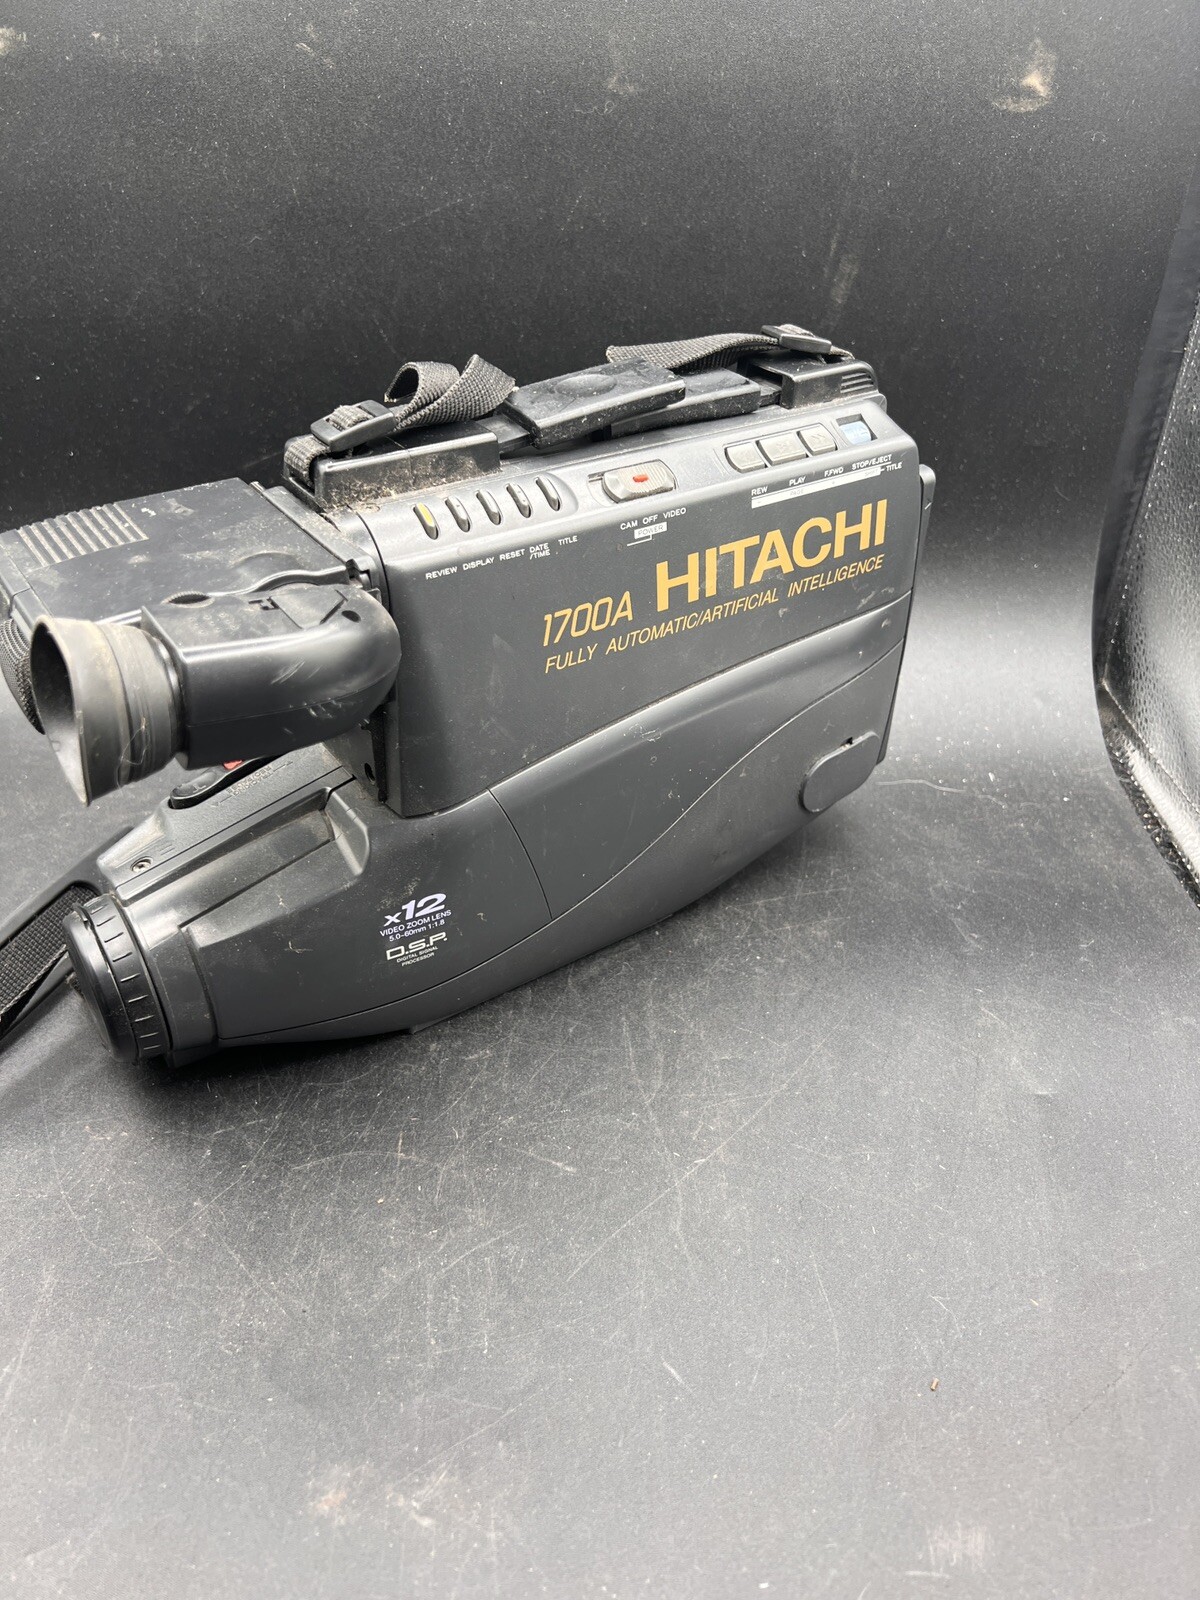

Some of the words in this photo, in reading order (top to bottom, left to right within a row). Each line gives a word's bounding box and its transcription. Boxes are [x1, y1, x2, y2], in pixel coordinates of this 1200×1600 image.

[851, 454, 892, 471] STOP/EJECT
[886, 462, 903, 472] TITLE
[789, 475, 807, 487] PLAY
[751, 485, 769, 496] REW
[620, 520, 638, 530] CAM
[642, 514, 658, 525] OFF
[663, 507, 687, 519] VIDEO
[637, 524, 664, 536] POWER
[529, 543, 549, 553] DATE
[558, 535, 578, 546] TITLE
[529, 549, 551, 561] /TIME
[656, 499, 888, 612] HITACHI
[425, 566, 458, 580] REVIEW
[462, 557, 495, 571] DISPLAY
[499, 549, 526, 561] RESET
[542, 590, 634, 647] 1700A
[544, 644, 600, 674] FULLY
[605, 587, 779, 656] AUTOMATIC/ARTIFICIAL
[787, 553, 886, 598] INTELLIGENCE
[383, 893, 447, 927] x12
[379, 925, 405, 937] VIDEO
[406, 916, 431, 929] ZOOM
[431, 909, 452, 921] LENS
[427, 919, 446, 930] 1:1.8
[386, 931, 448, 960] D.S.P.
[396, 952, 418, 963] DIGITAL
[418, 945, 438, 955] SIGNAL
[401, 952, 435, 967] PROCESSOR
